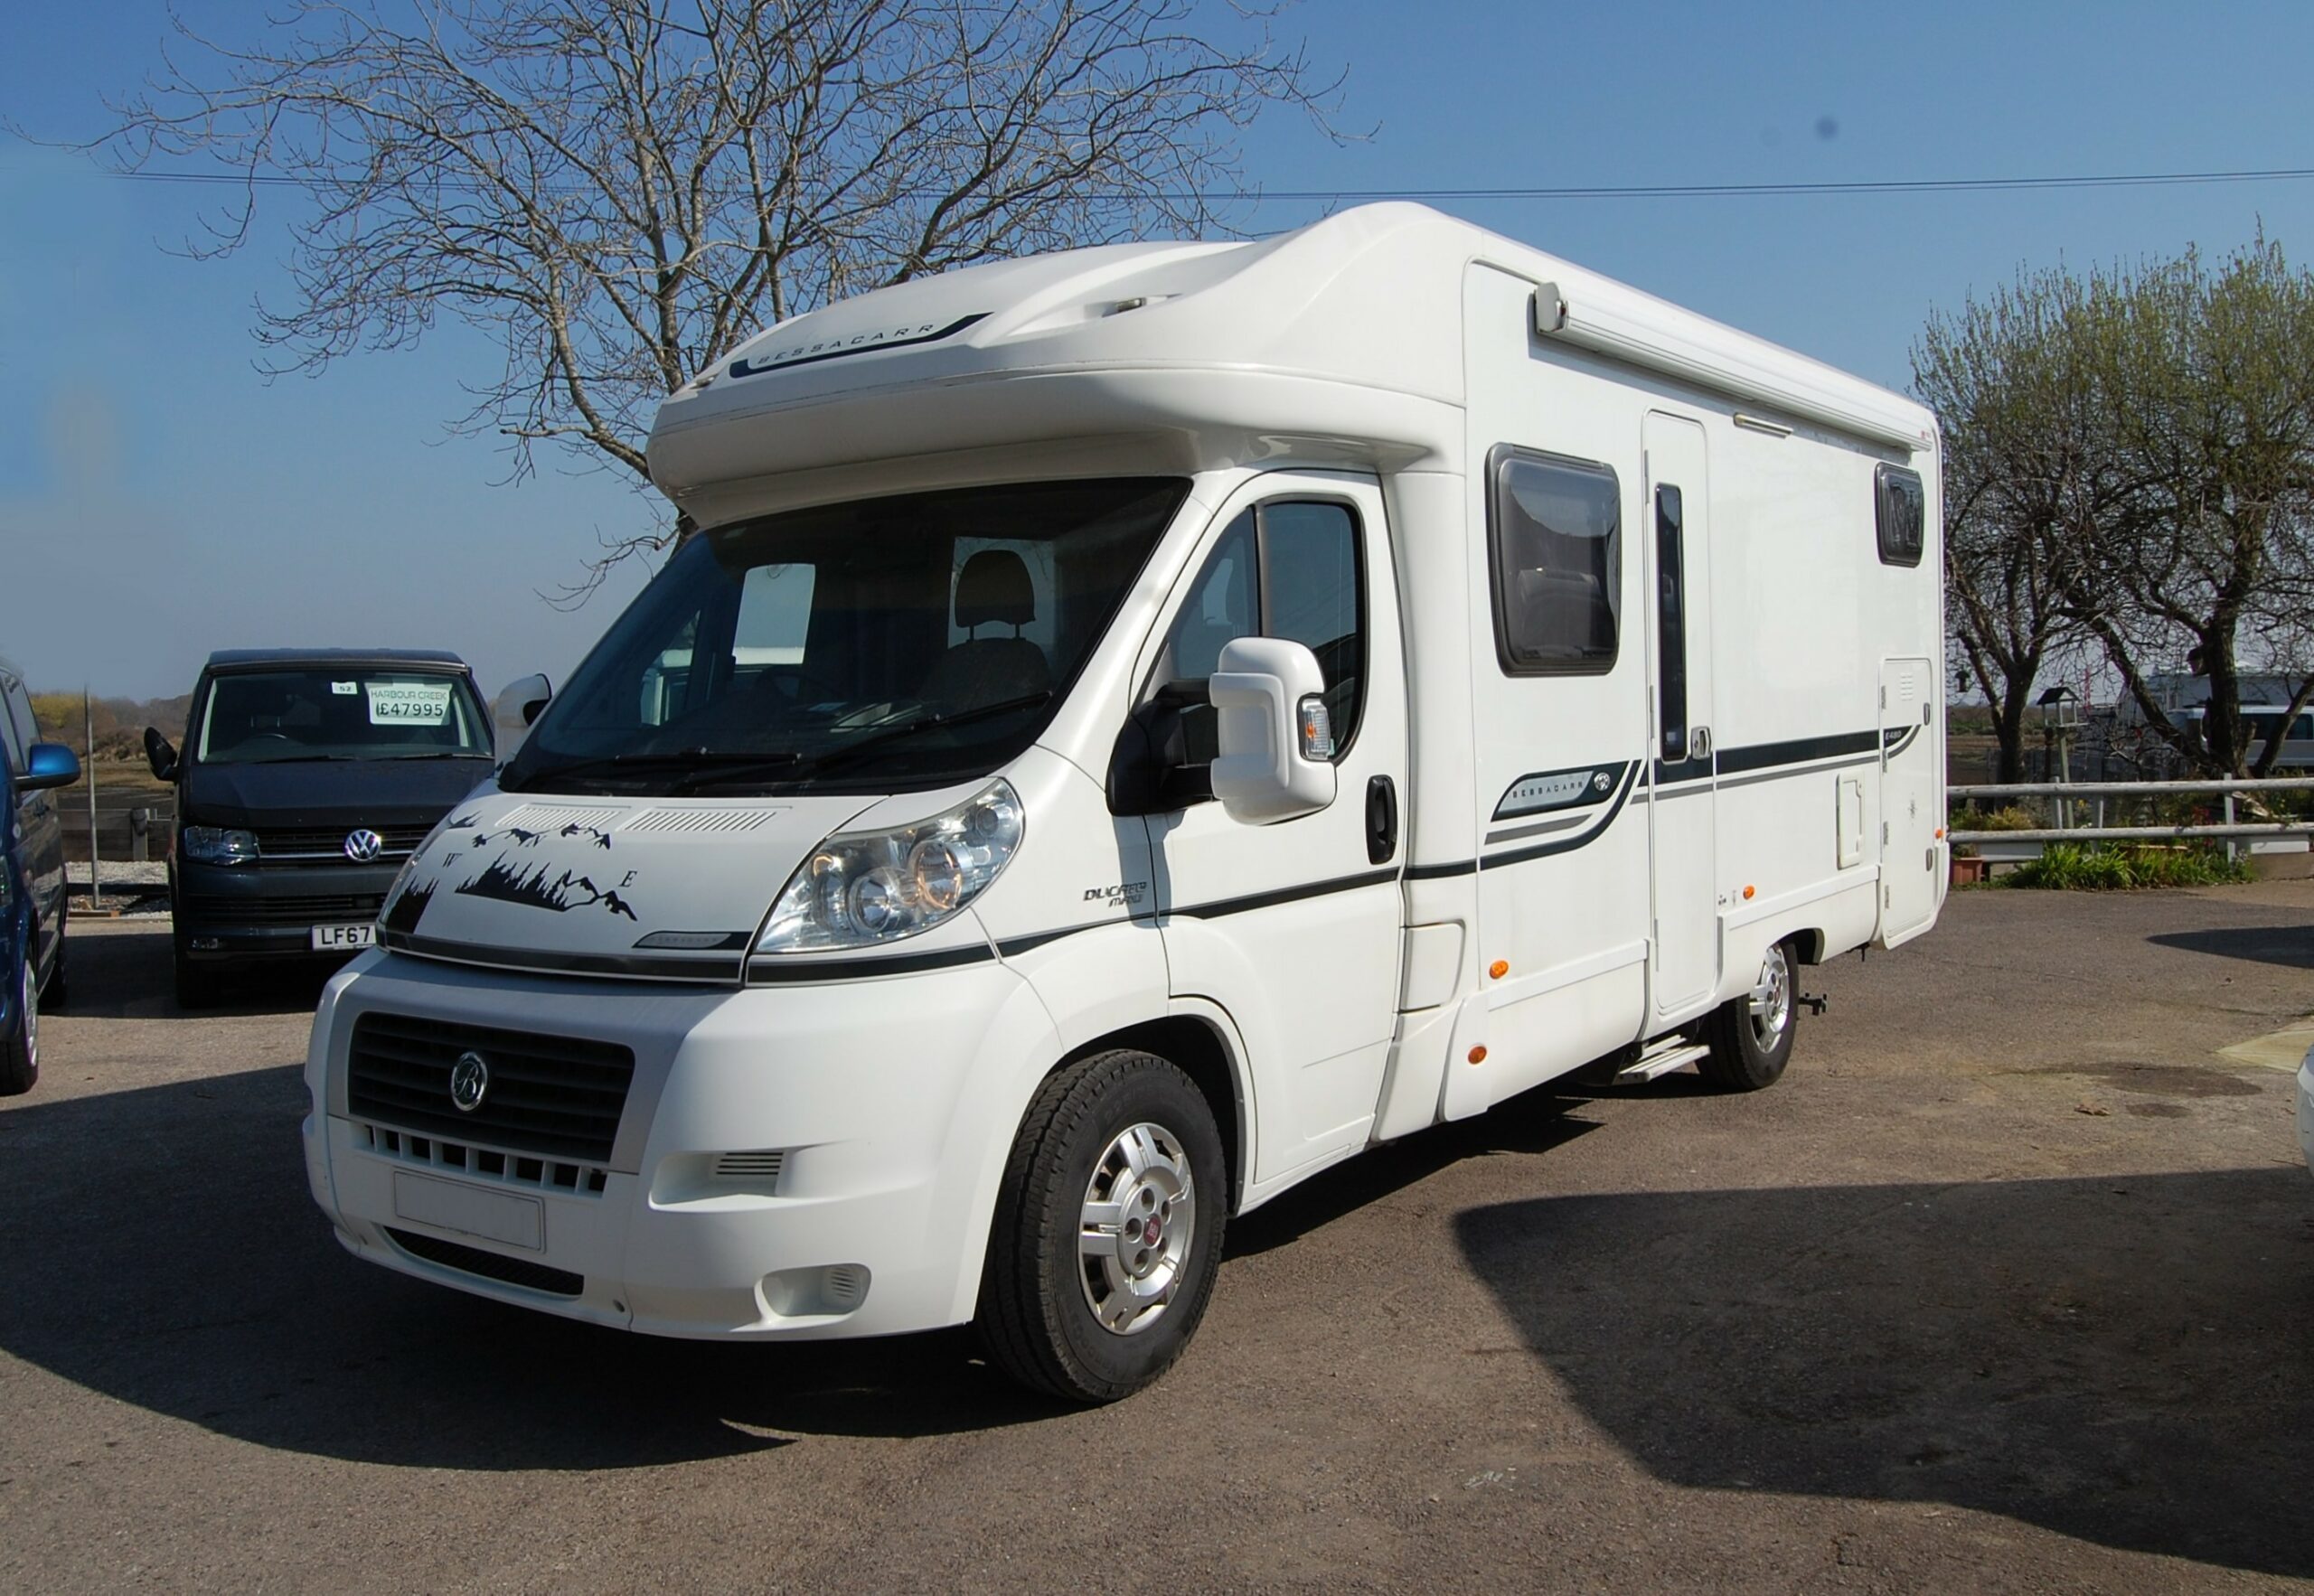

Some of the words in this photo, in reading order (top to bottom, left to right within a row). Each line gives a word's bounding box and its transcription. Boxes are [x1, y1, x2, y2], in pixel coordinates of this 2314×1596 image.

[757, 324, 934, 365] BESSACARR
[371, 690, 416, 700] HARBOUR
[418, 690, 447, 700] CREEK
[618, 869, 638, 887] E
[321, 926, 371, 945] LF67
